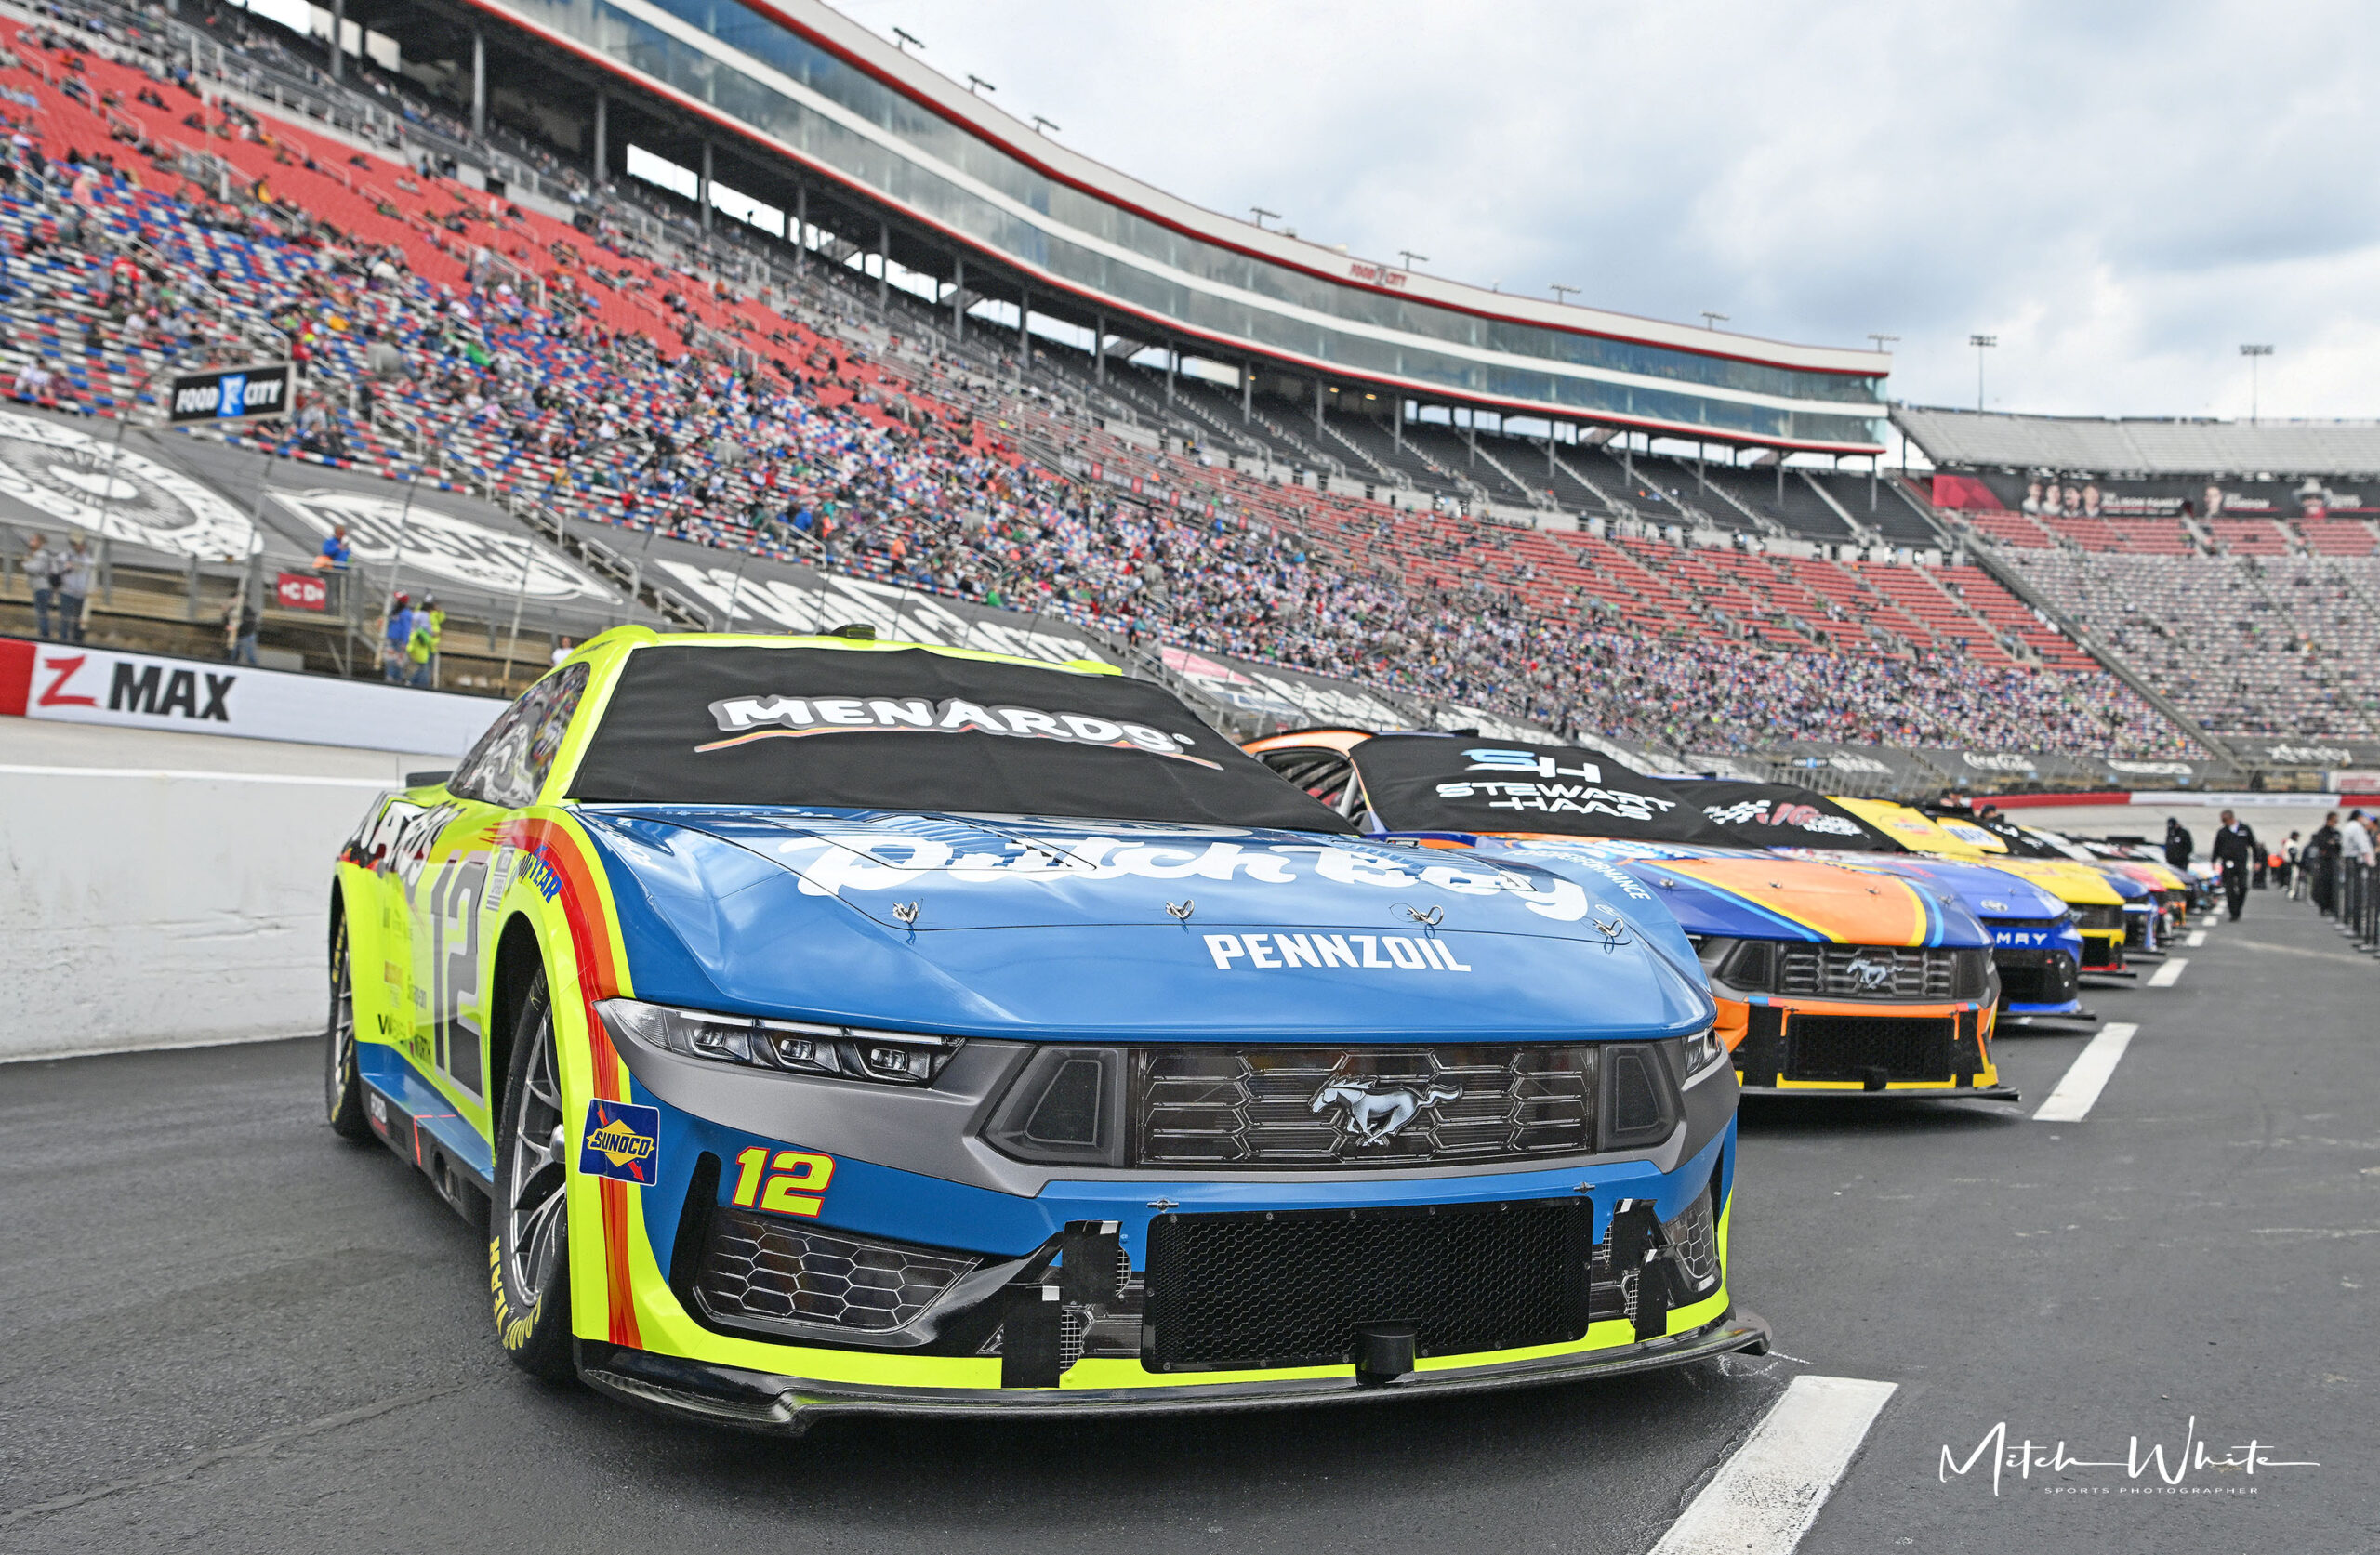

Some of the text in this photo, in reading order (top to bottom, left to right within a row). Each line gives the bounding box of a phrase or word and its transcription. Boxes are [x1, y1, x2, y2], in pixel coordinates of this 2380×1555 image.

[175, 386, 220, 413] FOOD
[244, 379, 283, 406] CITY
[107, 661, 237, 722] MAX
[1435, 781, 1676, 812] STEWART
[1488, 797, 1652, 821] HAAS
[1205, 934, 1472, 973] PENNZOIL
[591, 1131, 652, 1157] SUNOCO
[731, 1145, 836, 1219] 12
